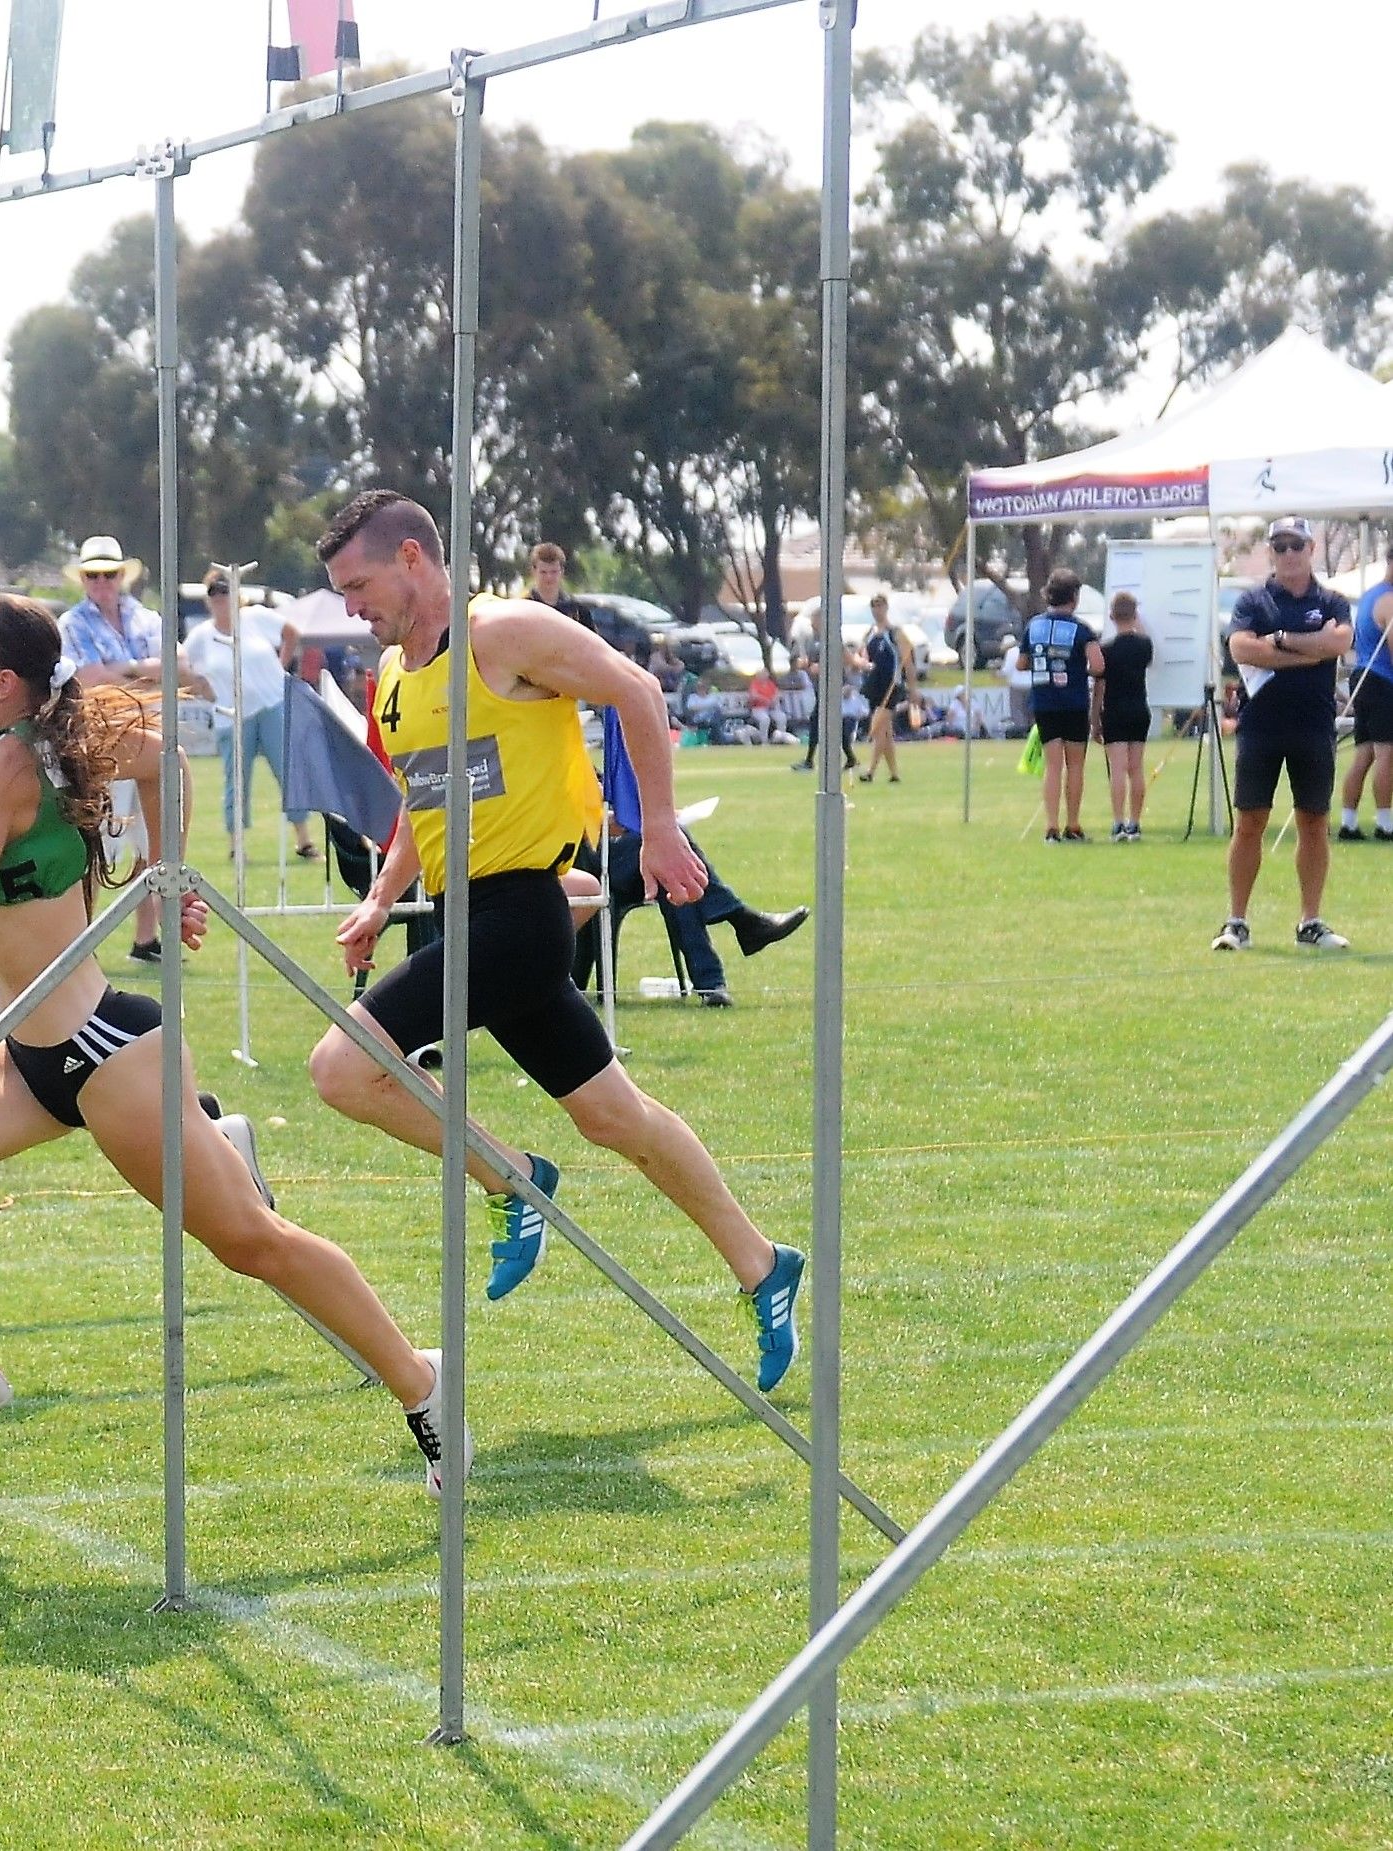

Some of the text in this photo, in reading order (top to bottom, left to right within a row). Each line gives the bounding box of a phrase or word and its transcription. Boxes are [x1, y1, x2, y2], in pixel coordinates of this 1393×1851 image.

[976, 484, 1203, 514] VICTORIAN ATHLETIC LEAGUE
[380, 679, 401, 733] 4
